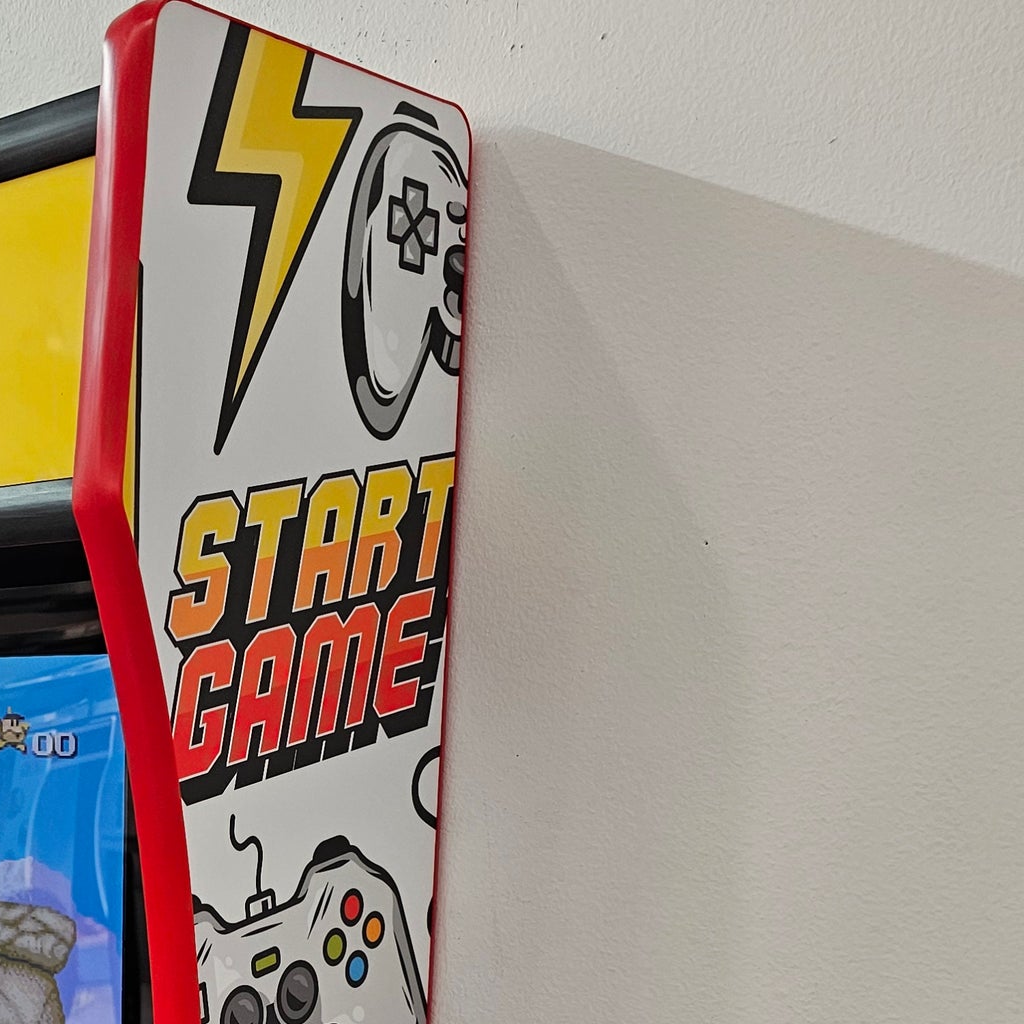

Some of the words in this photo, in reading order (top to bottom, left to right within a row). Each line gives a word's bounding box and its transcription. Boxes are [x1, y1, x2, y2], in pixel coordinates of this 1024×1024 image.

[166, 453, 455, 646] START
[32, 732, 78, 758] 00
[172, 587, 437, 783] GAME
